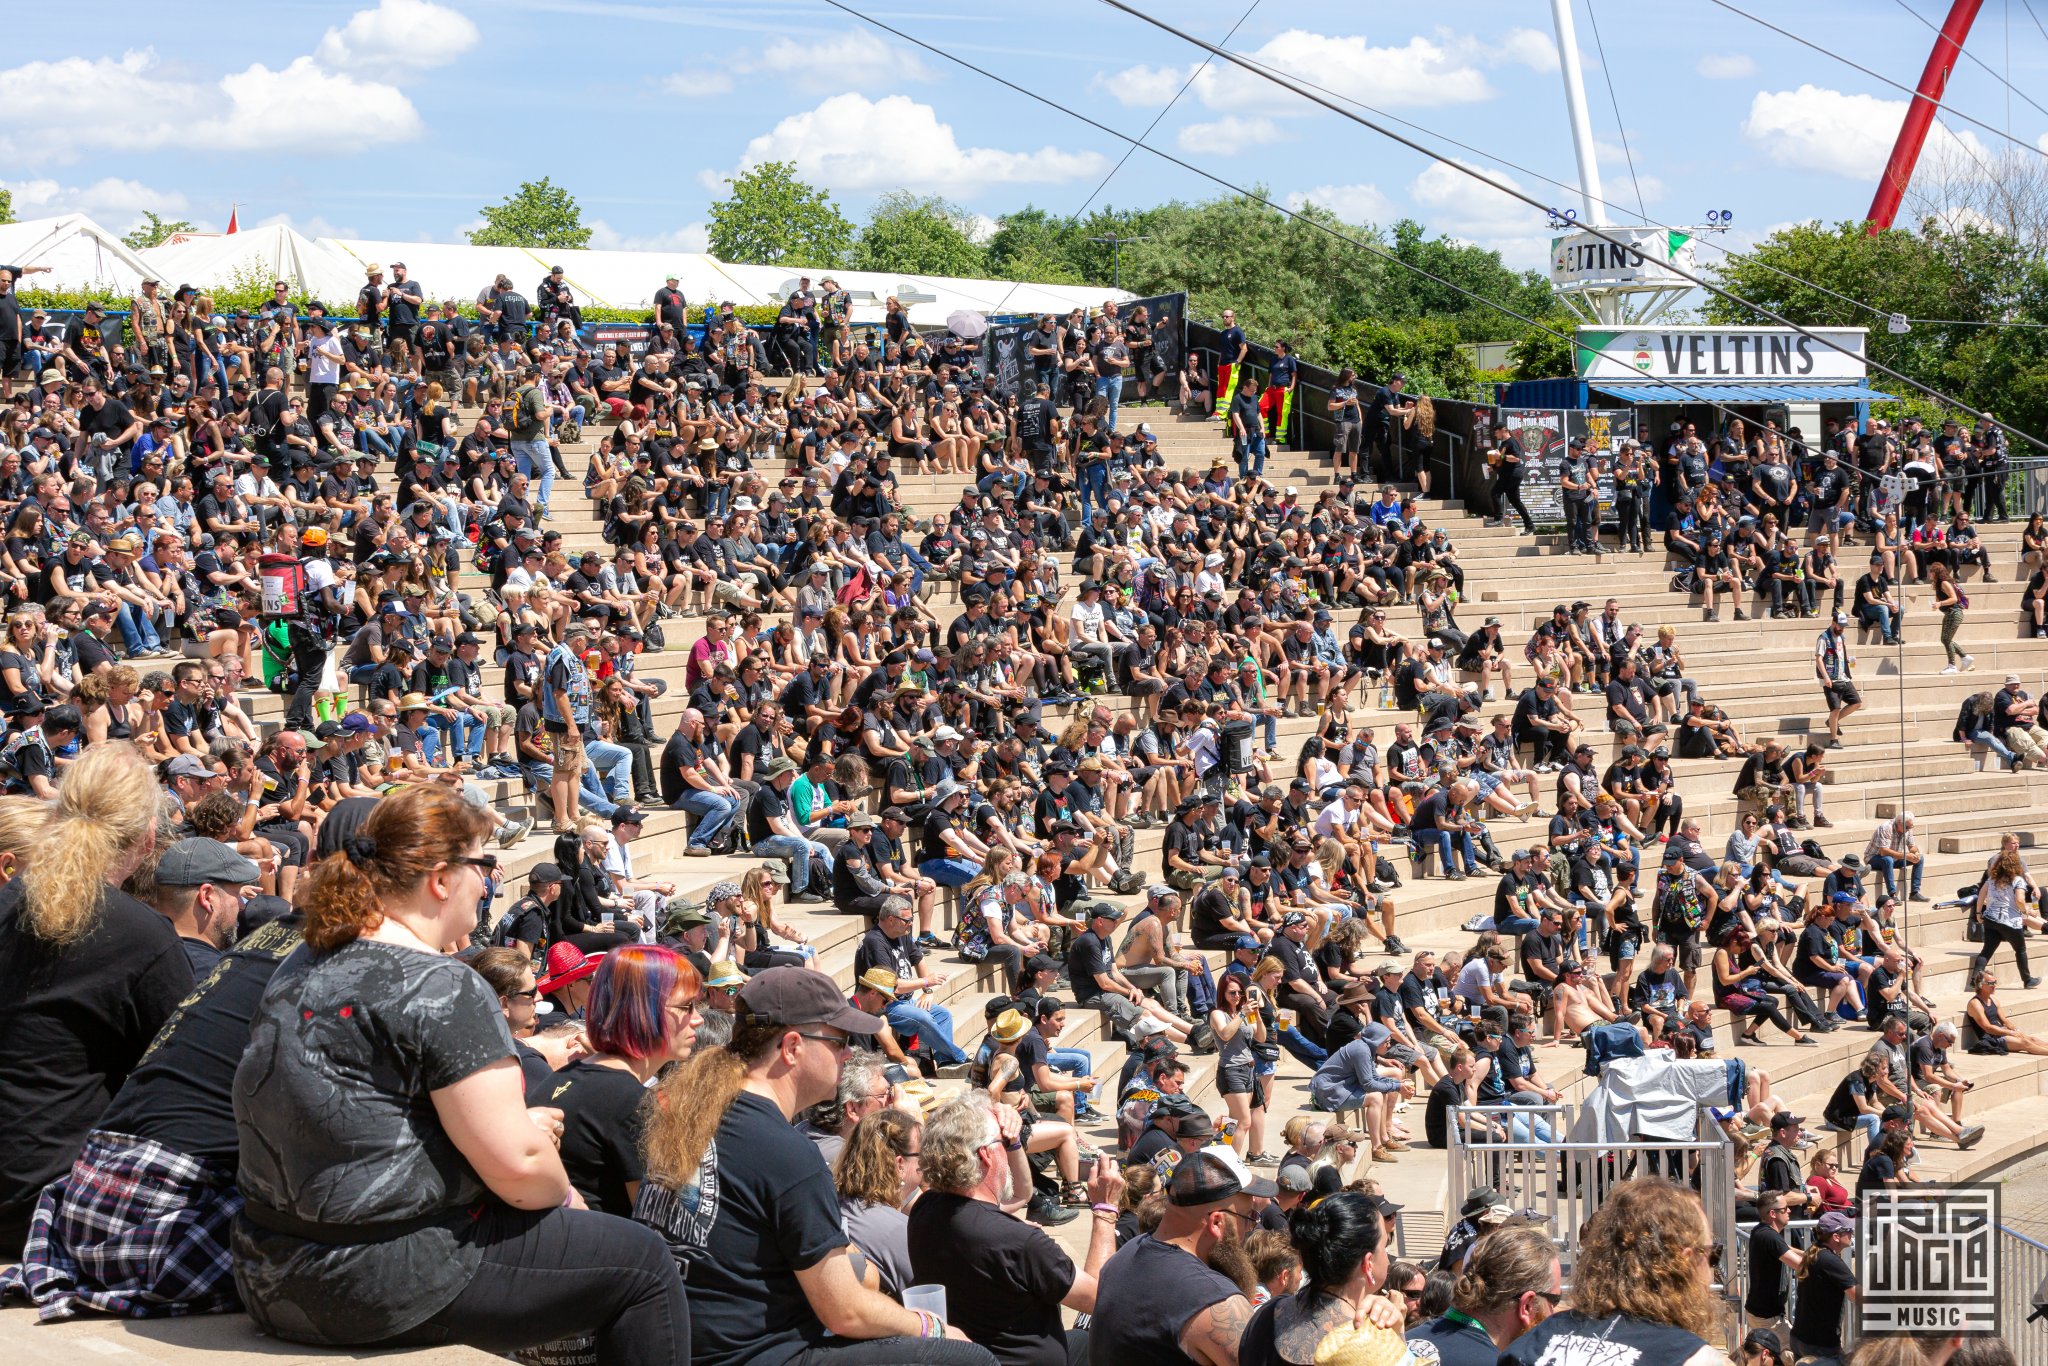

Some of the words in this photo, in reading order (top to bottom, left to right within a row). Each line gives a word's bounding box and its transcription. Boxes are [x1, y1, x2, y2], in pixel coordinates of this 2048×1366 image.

[1661, 335, 1814, 375] VELTINS
[668, 1197, 708, 1248] CRUISE
[540, 1336, 595, 1352] OWERWOLF
[541, 1356, 559, 1365] DOG
[579, 1353, 597, 1364] DOG
